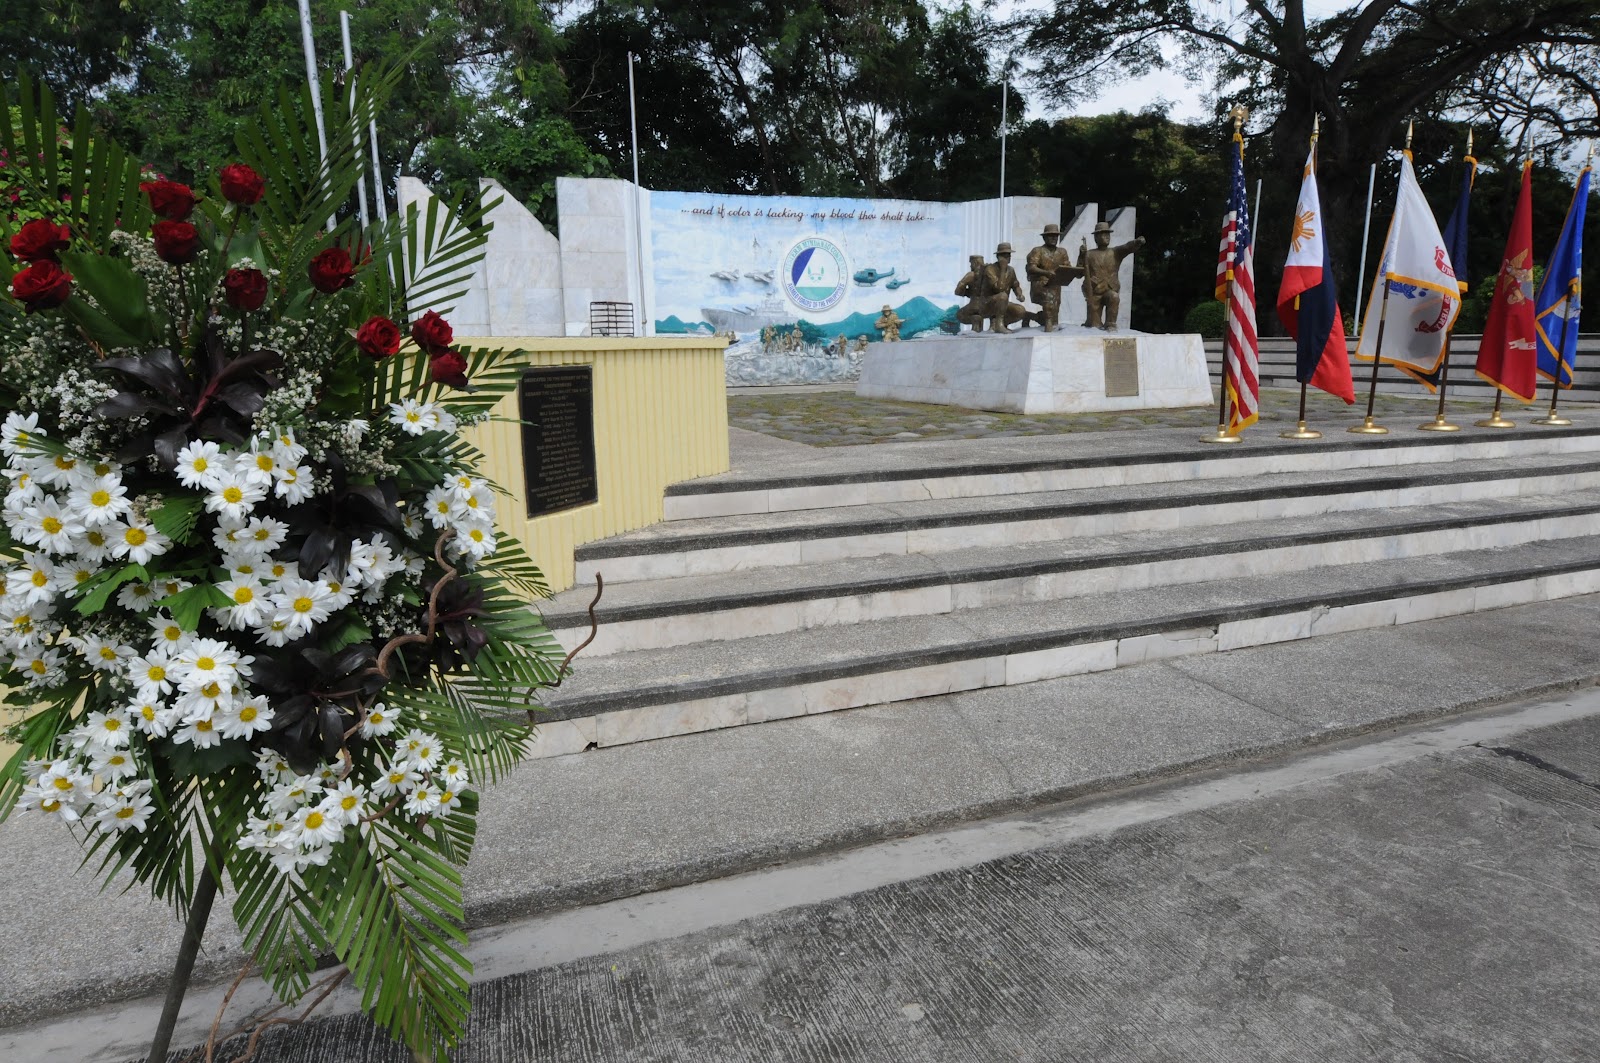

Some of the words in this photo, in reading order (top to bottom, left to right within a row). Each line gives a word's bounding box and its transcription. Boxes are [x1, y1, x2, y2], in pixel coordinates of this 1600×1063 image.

[718, 204, 724, 218] if
[727, 206, 751, 216] color
[754, 208, 764, 216] is
[766, 208, 804, 222] lacking
[810, 212, 826, 222] my
[830, 208, 856, 220] blood
[858, 211, 876, 220] thou
